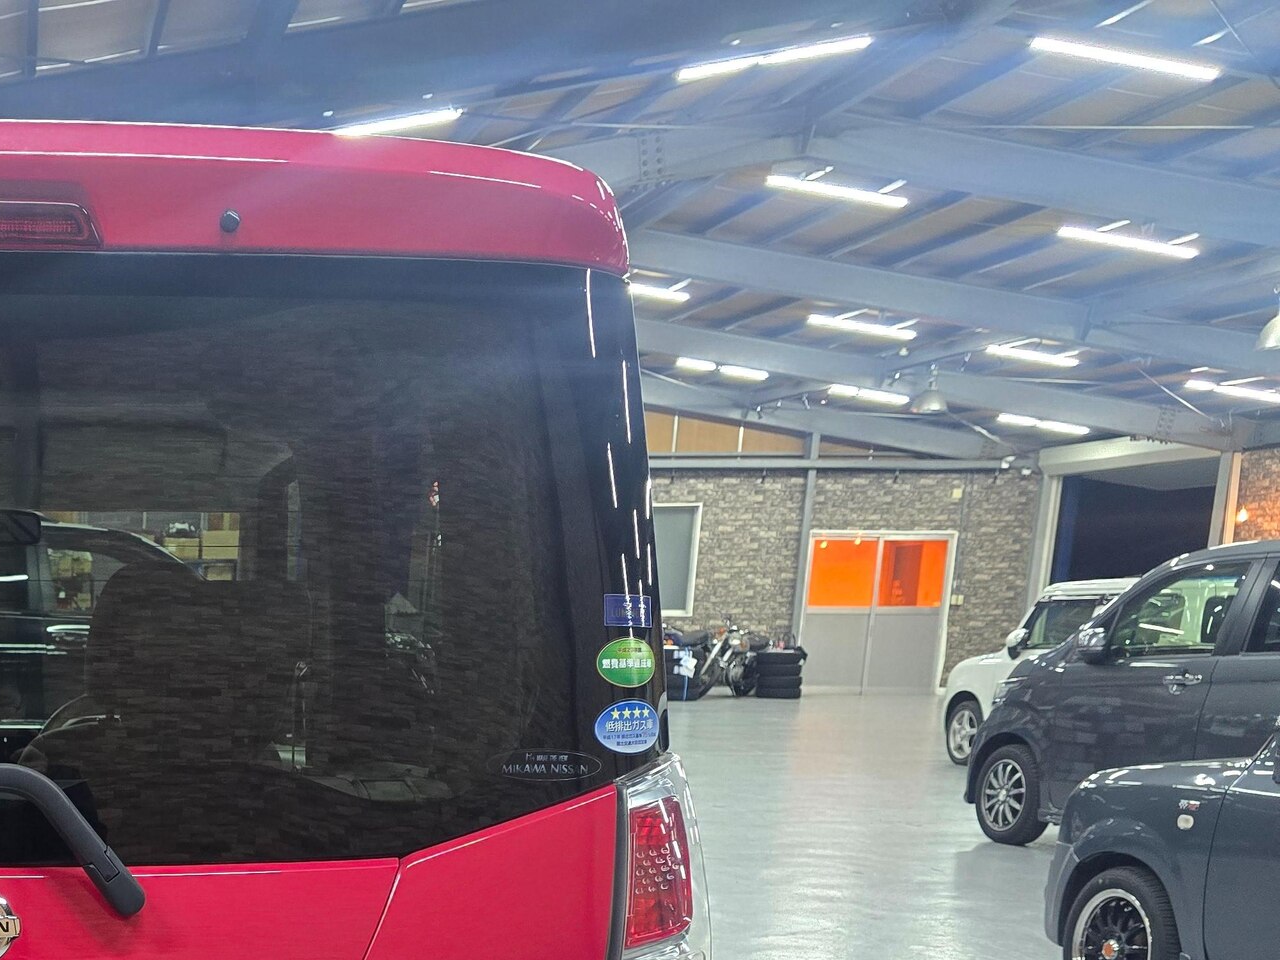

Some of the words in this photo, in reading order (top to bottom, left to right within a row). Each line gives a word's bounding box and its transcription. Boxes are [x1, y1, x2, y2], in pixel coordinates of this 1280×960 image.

[605, 720, 654, 733] 低排出ガス車
[502, 764, 547, 774] MIKAWA
